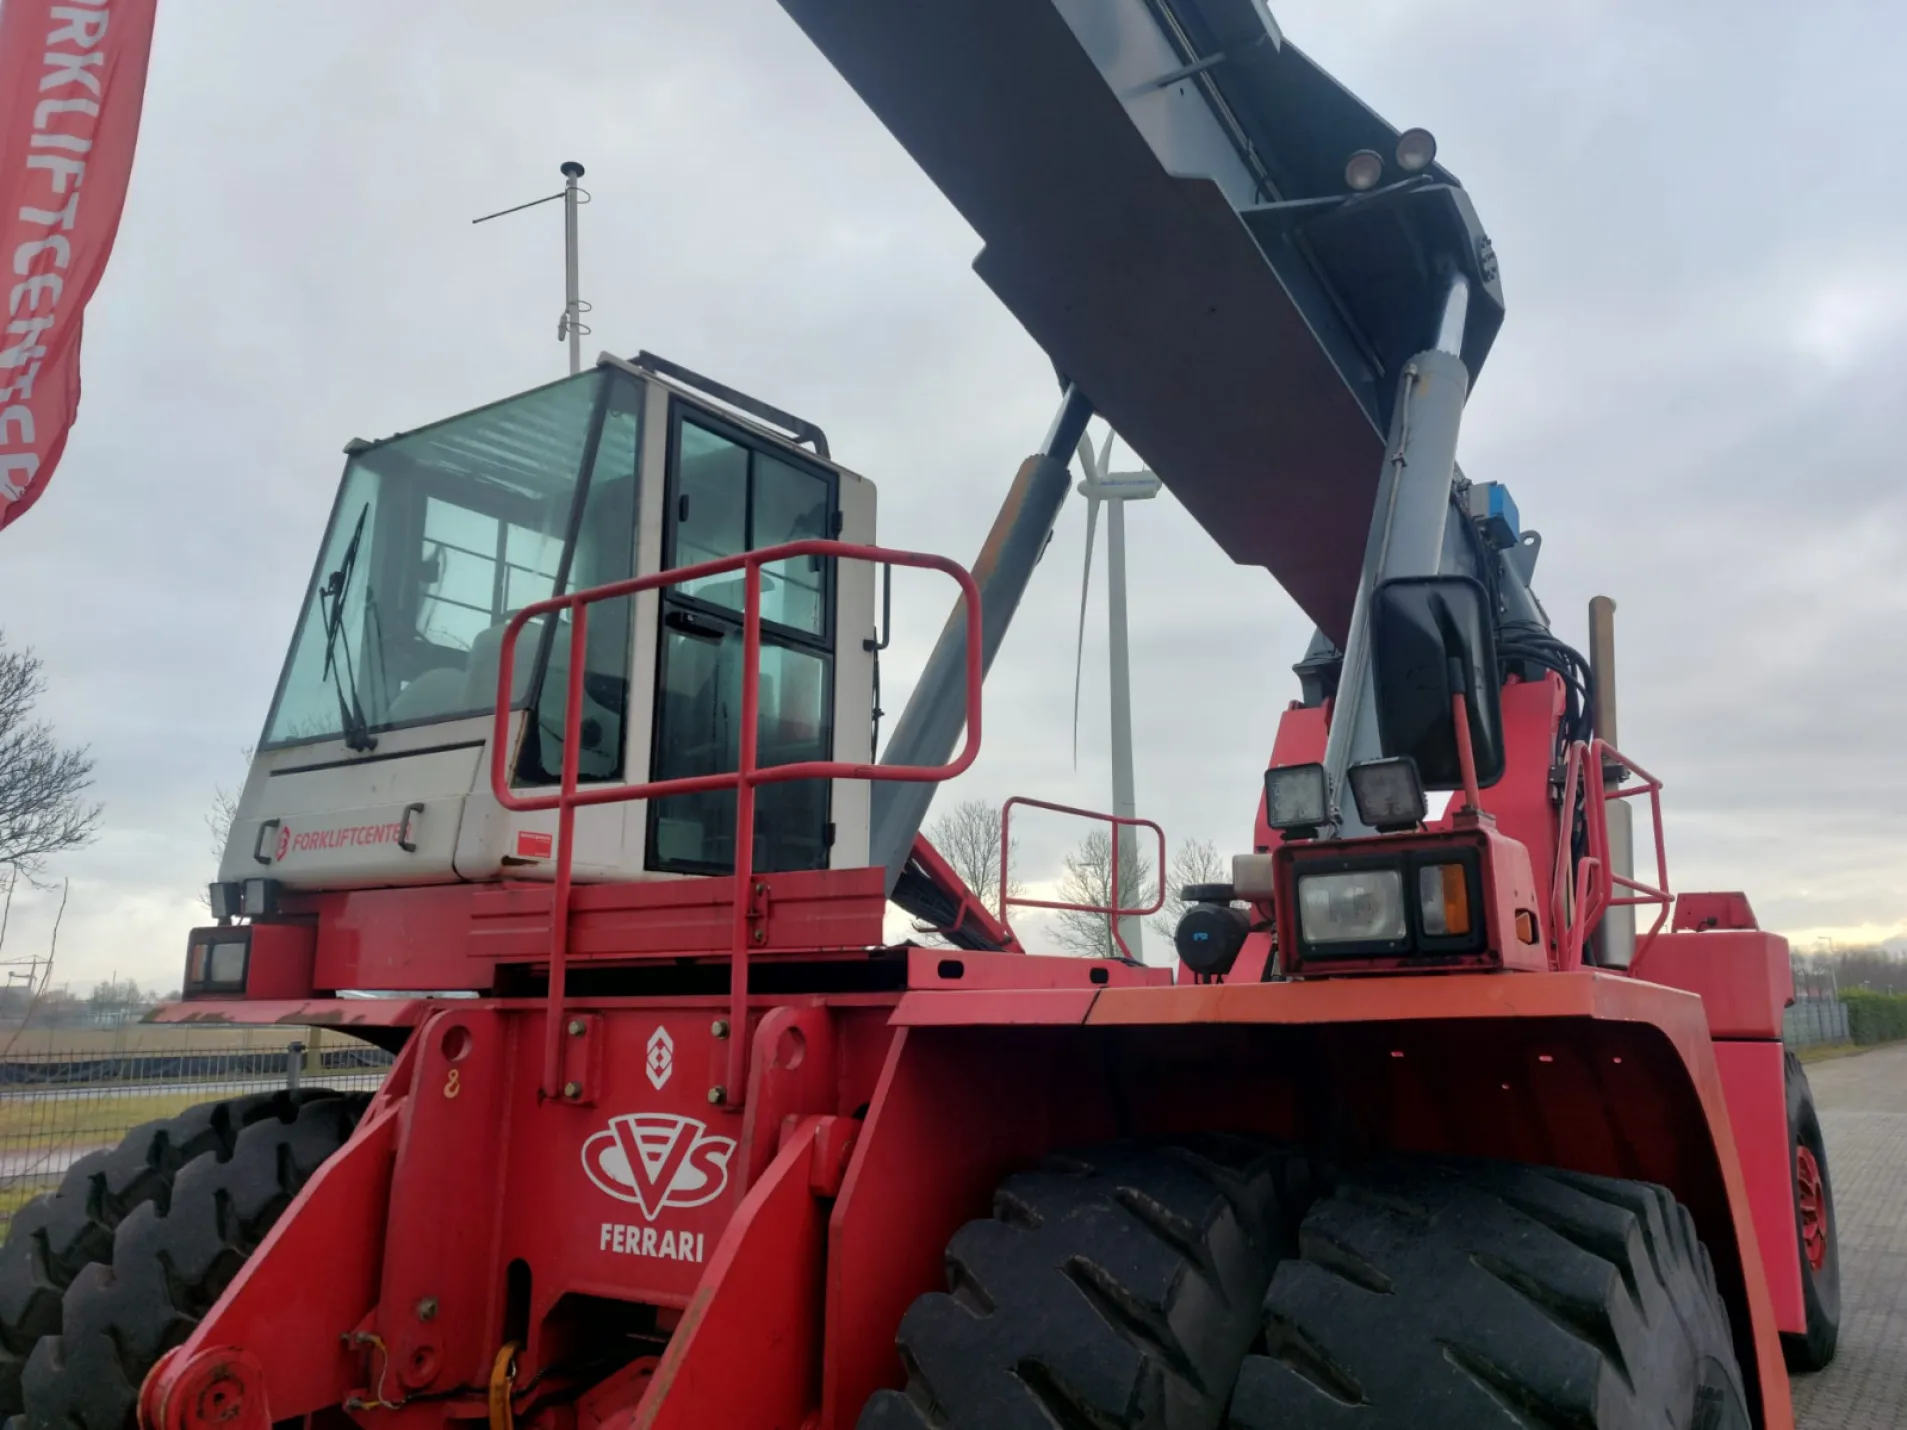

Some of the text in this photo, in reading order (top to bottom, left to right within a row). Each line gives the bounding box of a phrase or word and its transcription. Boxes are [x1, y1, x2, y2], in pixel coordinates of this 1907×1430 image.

[0, 0, 109, 502] RKLIFTCENTER
[581, 1112, 737, 1221] CVS
[600, 1223, 704, 1262] FERRARI
